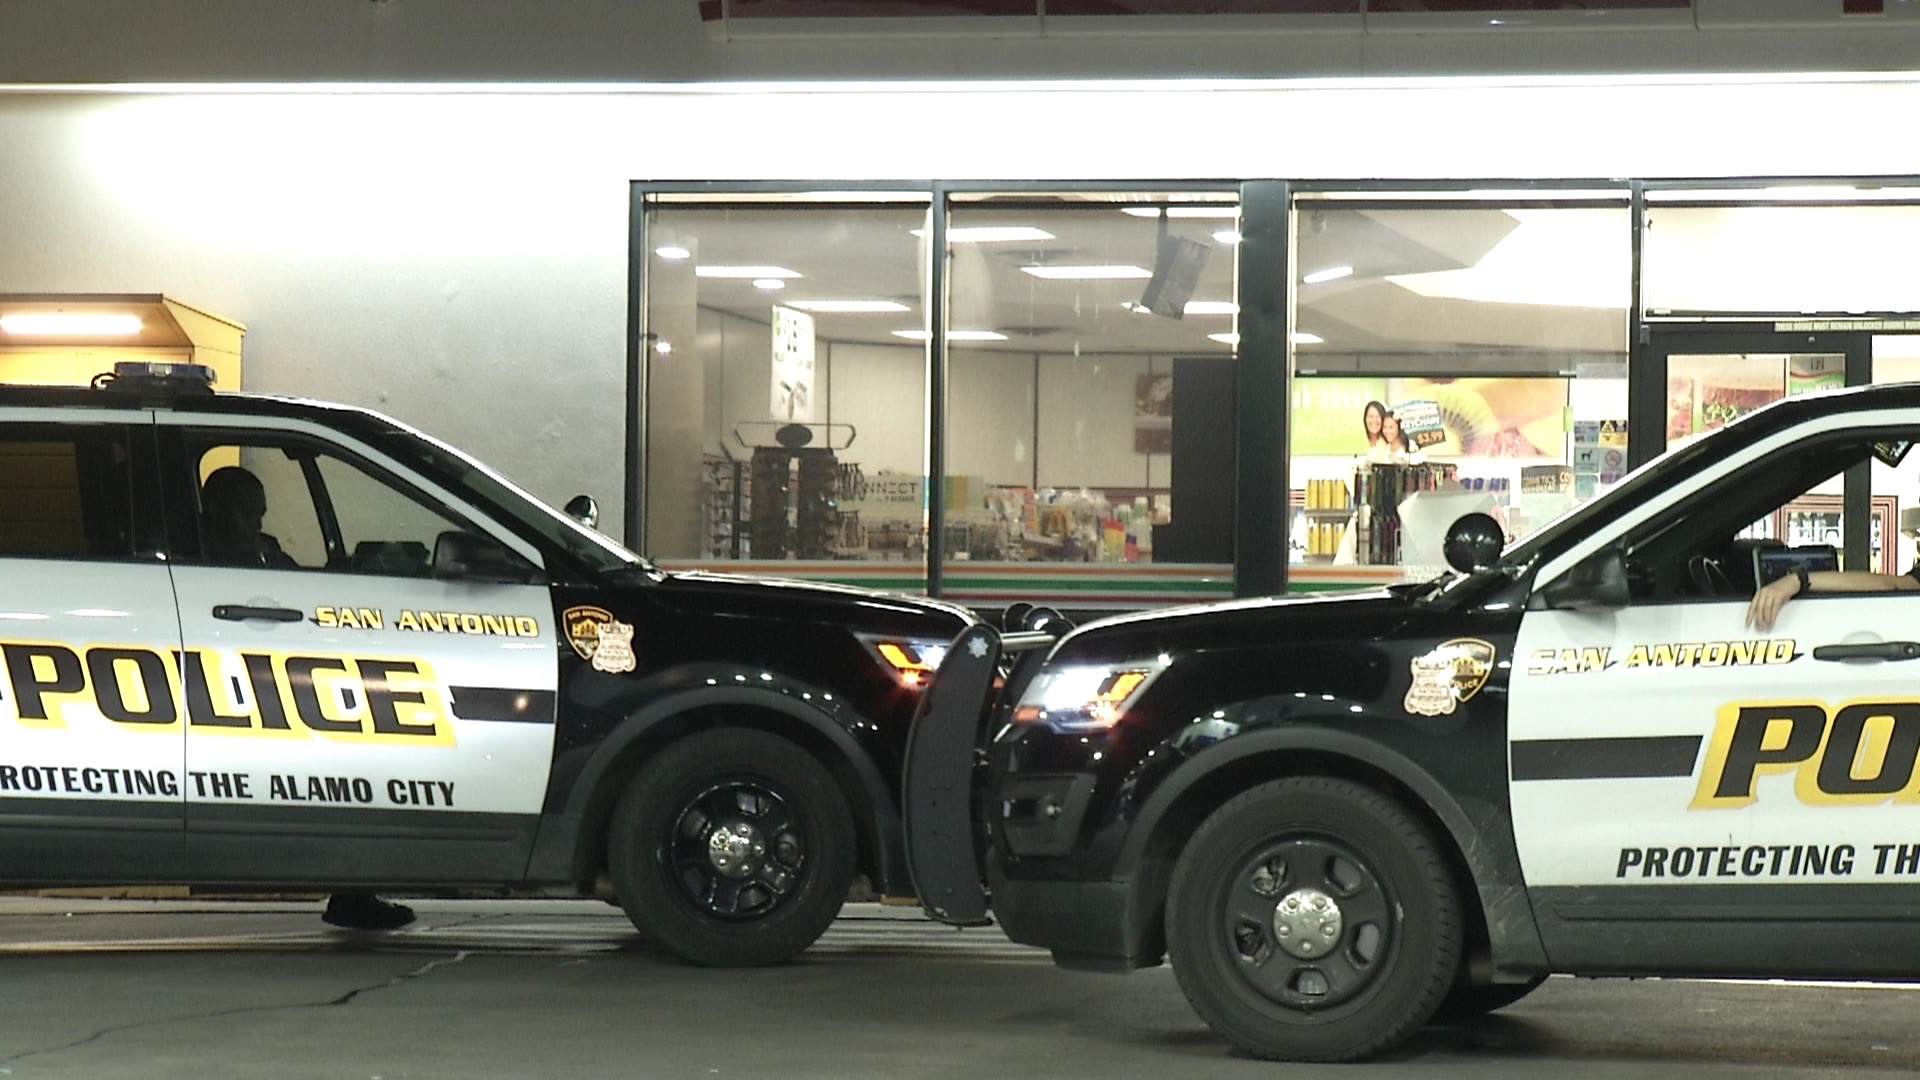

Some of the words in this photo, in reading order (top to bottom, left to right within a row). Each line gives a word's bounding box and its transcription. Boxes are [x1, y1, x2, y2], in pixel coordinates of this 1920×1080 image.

[1417, 431, 1444, 445] $3.99
[863, 482, 919, 494] NNECT
[317, 606, 383, 630] SAN
[398, 609, 538, 637] ANTONIO
[1528, 647, 1613, 676] SAN
[1624, 638, 1797, 669] ANTONIO
[0, 642, 438, 738] POLICE
[0, 764, 179, 797] ROTECTING
[189, 771, 253, 799] THE
[269, 775, 374, 804] ALAMO
[387, 779, 455, 807] CITY
[1616, 844, 1855, 878] PROTECTING
[1873, 844, 1920, 875] TH
